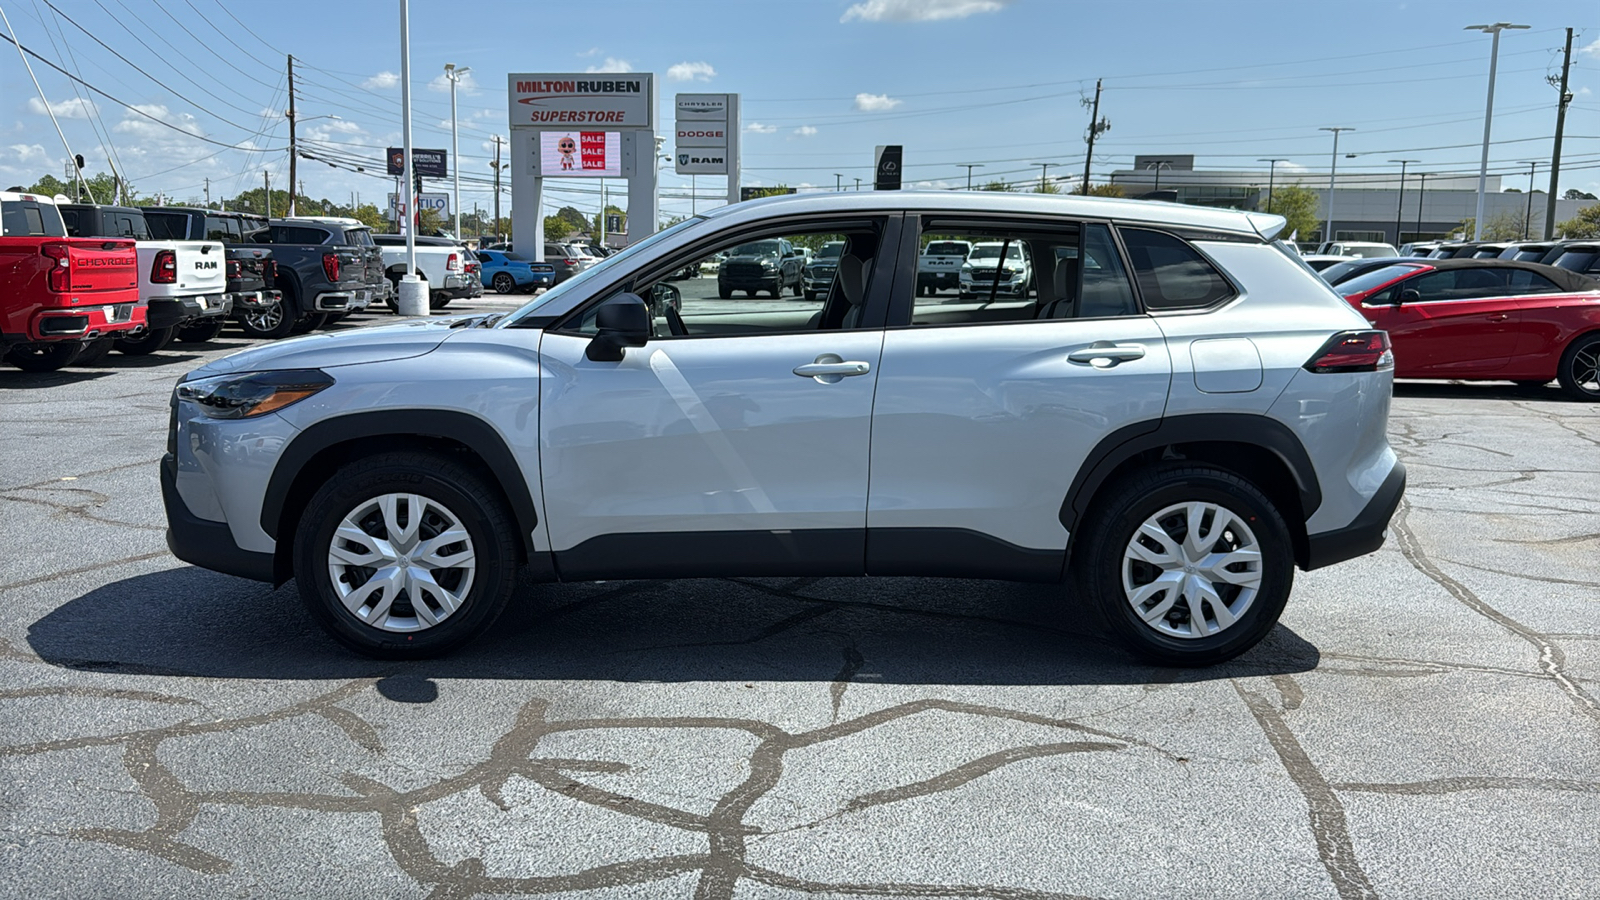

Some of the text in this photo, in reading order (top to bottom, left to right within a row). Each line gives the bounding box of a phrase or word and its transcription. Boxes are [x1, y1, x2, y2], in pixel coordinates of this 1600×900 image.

[531, 111, 625, 123] SUPERSTORE
[581, 135, 604, 143] SALE!
[77, 257, 135, 267] CHEVROLET
[195, 261, 217, 270] RAM
